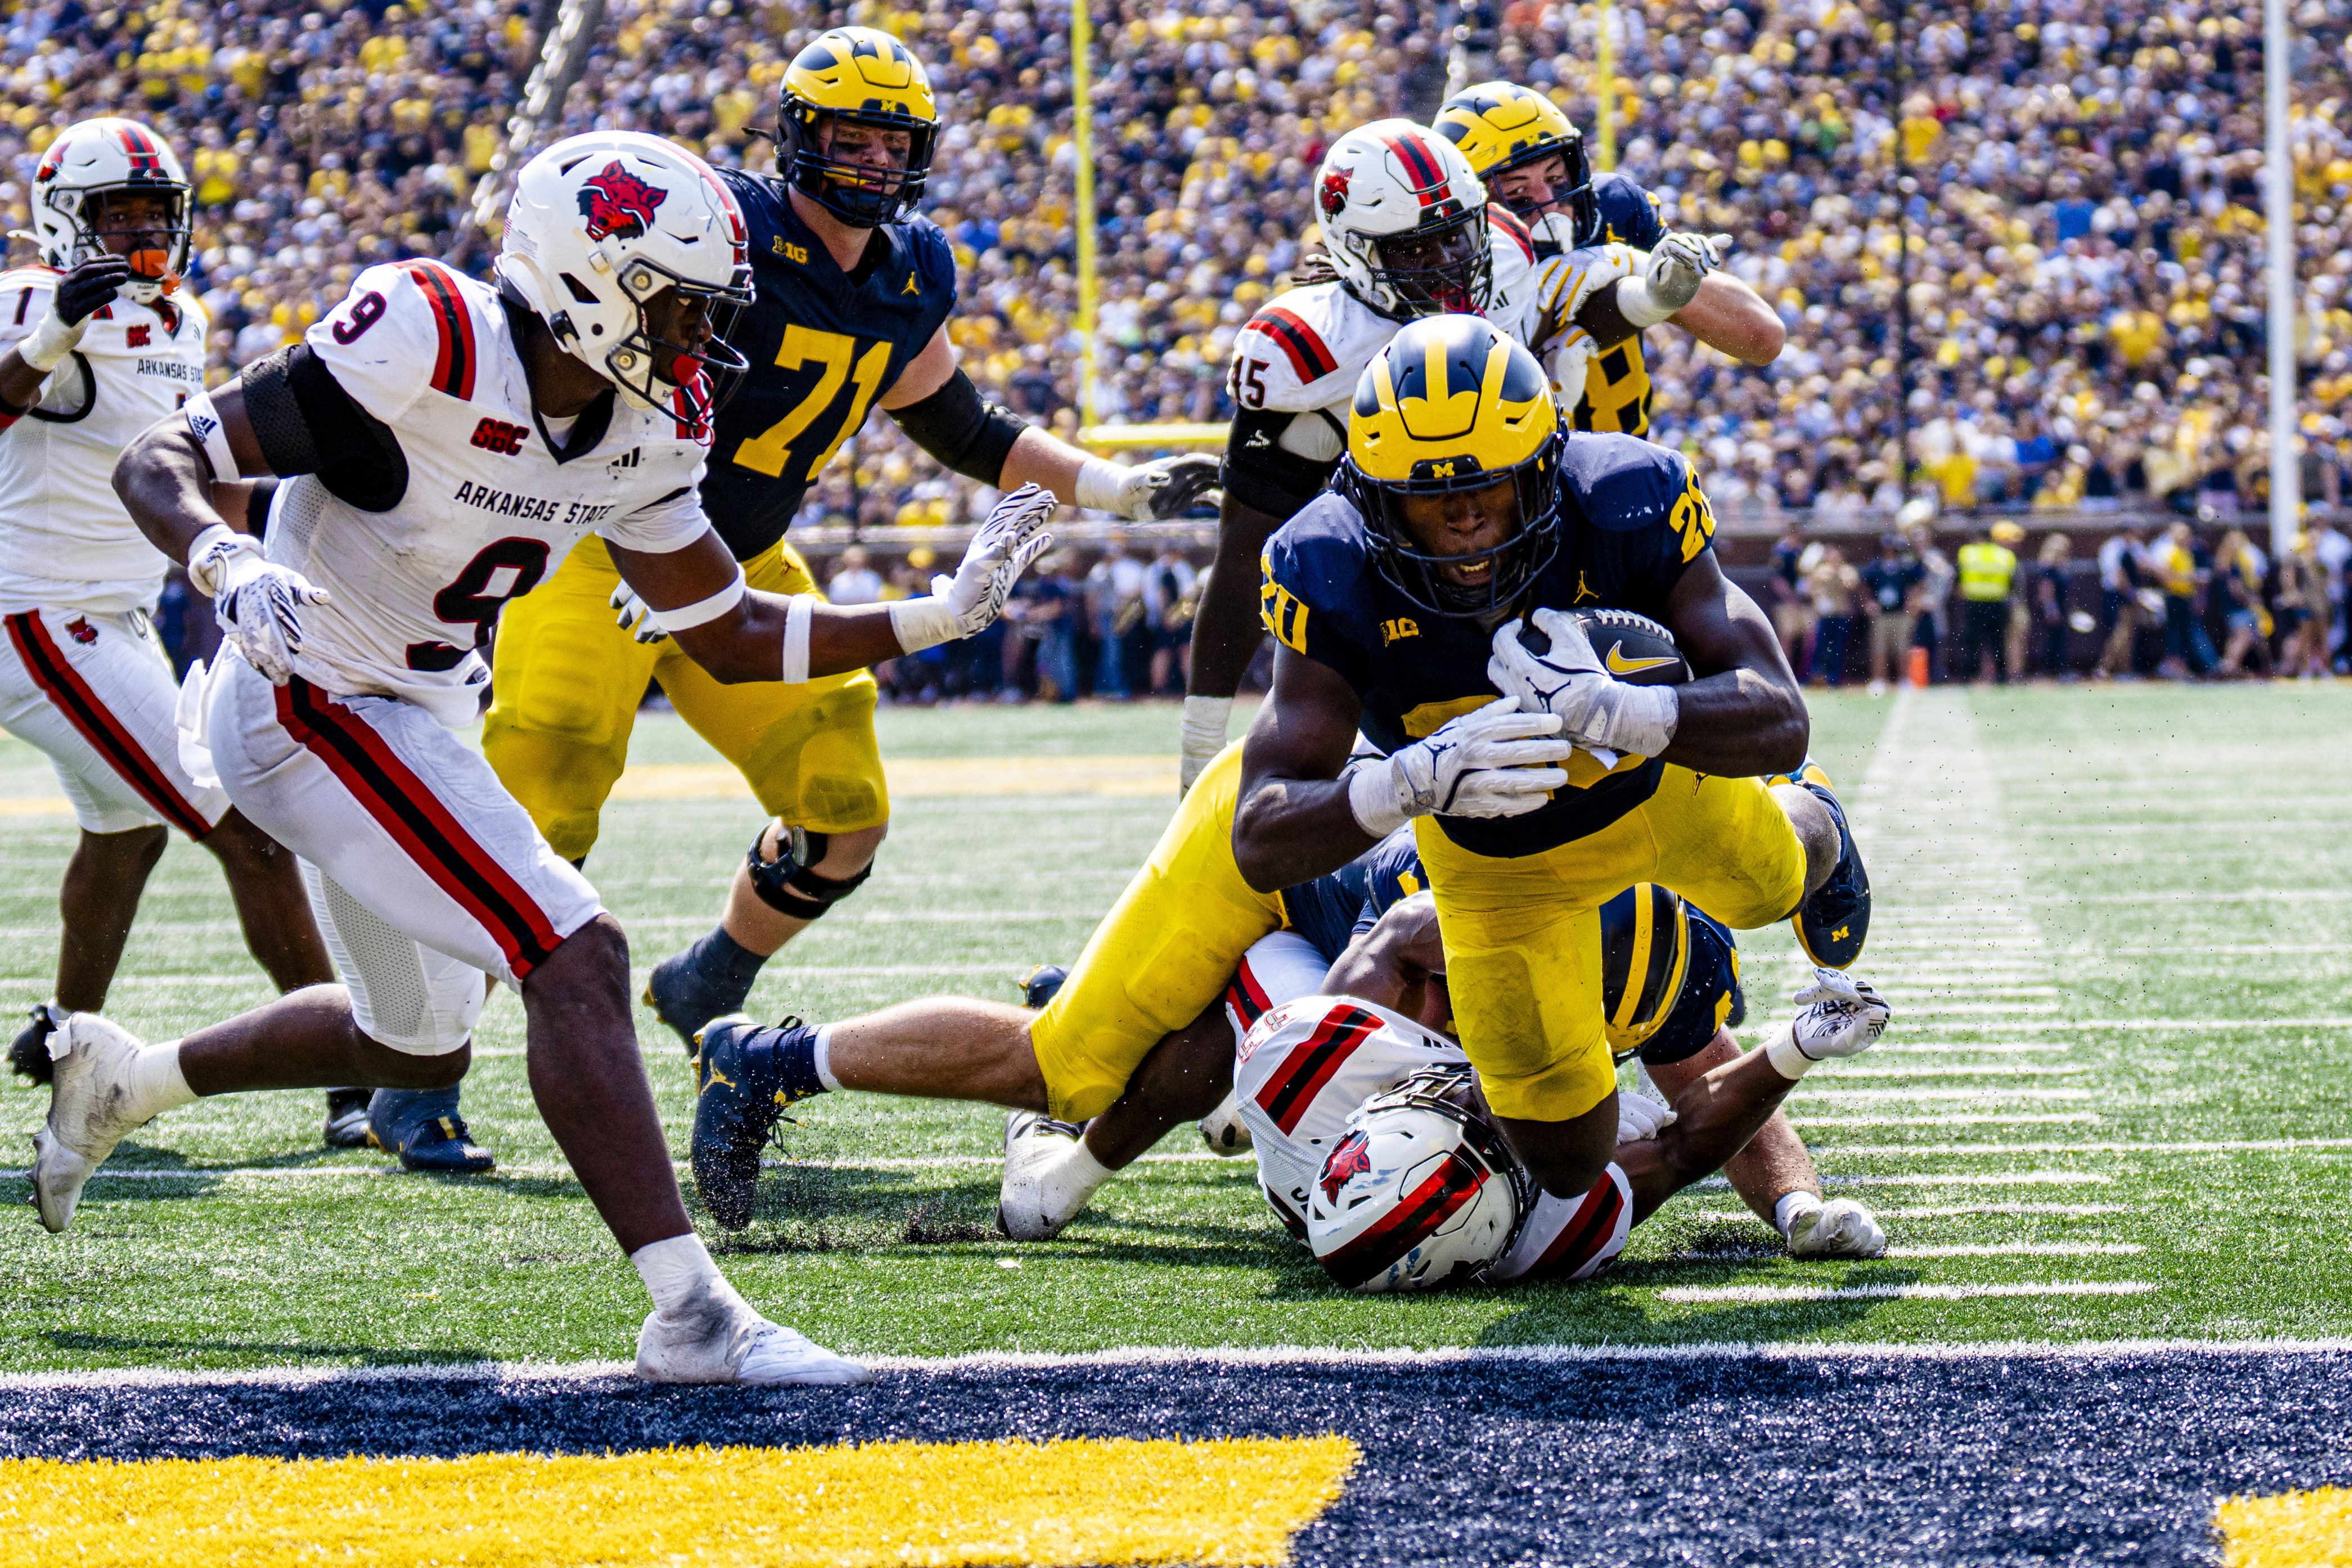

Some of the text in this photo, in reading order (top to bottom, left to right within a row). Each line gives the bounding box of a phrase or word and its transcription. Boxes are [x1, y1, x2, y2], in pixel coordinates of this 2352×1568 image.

[12, 285, 34, 325] 1
[332, 290, 387, 345] 9
[137, 358, 187, 380] ARKANSAS
[733, 324, 892, 482] 71
[1431, 462, 1455, 479] M
[454, 480, 616, 524] ARKANSAS STATE
[406, 536, 550, 671] 9
[1832, 925, 1849, 942] M
